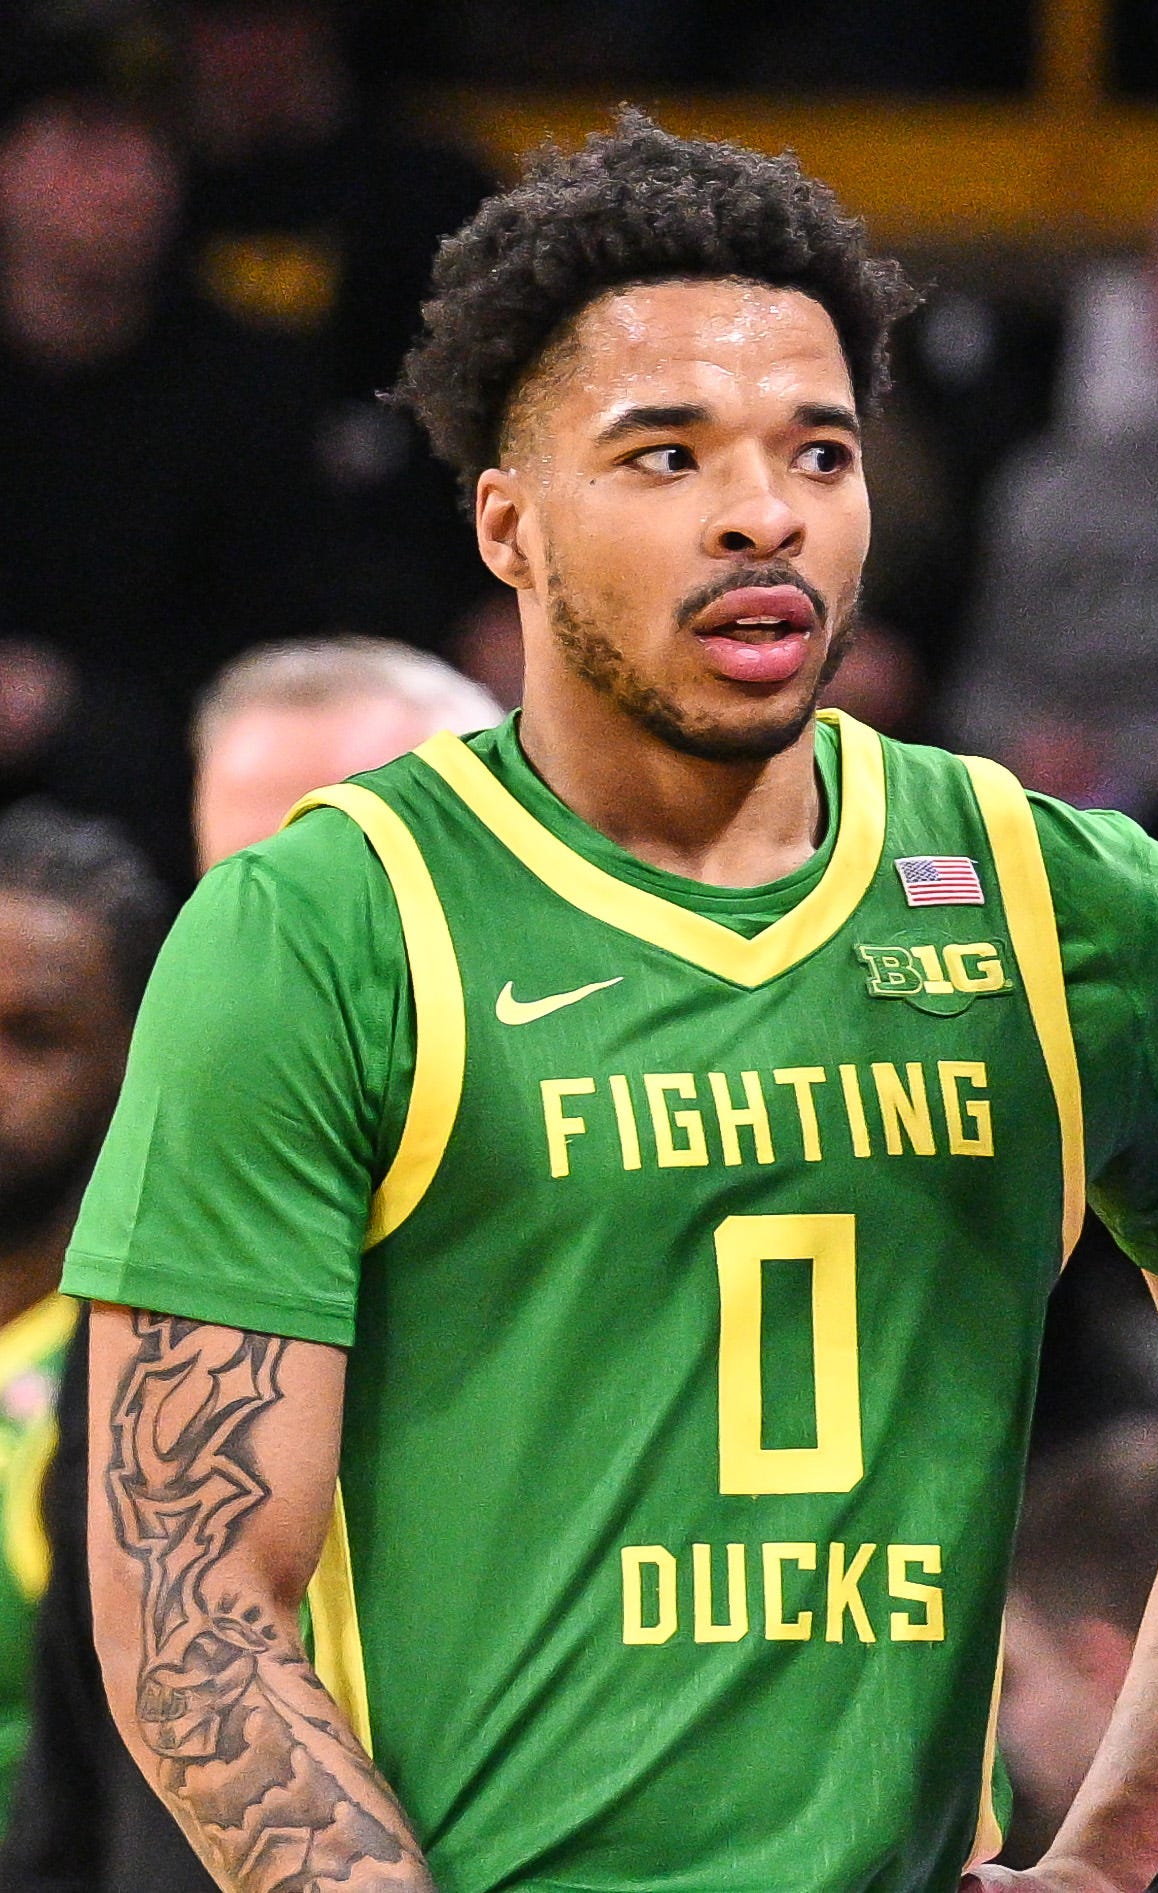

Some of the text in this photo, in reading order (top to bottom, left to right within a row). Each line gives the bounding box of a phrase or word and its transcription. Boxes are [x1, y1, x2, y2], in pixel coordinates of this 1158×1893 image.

[541, 1061, 994, 1178] FIGHTING
[714, 1214, 864, 1494] 0
[621, 1542, 945, 1645] DUCKS
